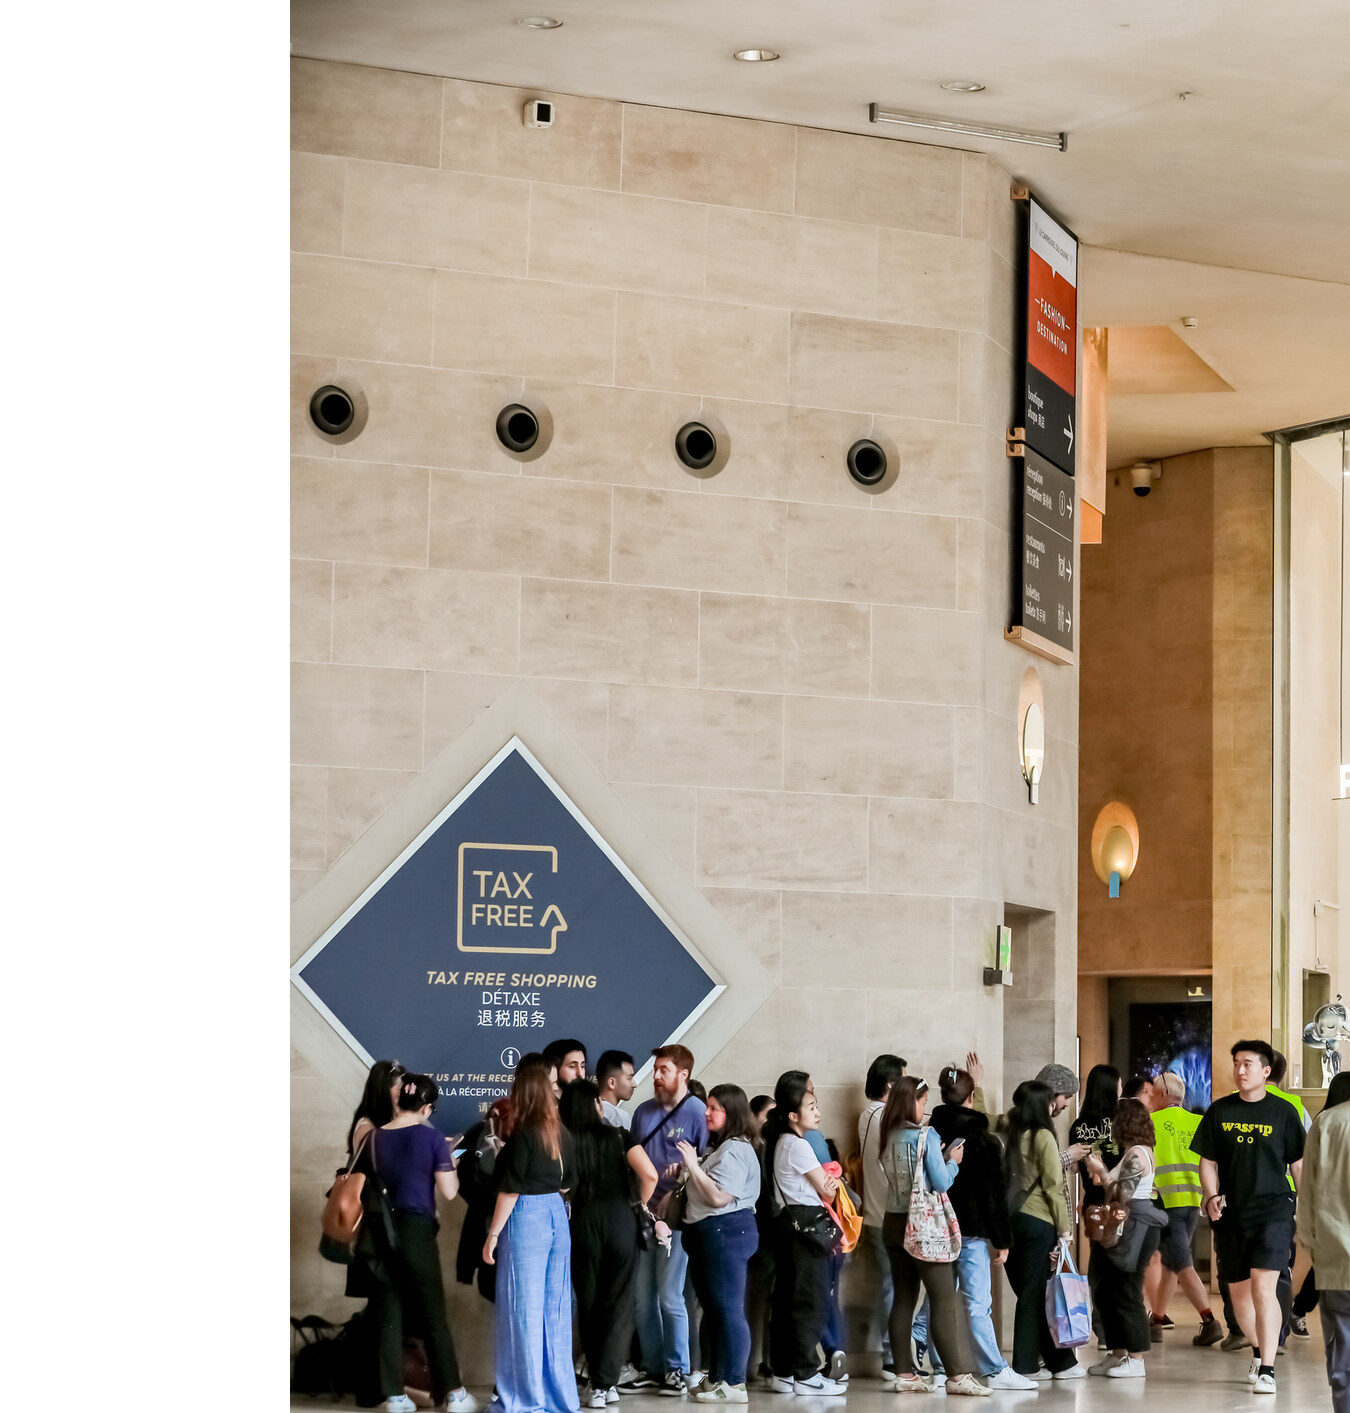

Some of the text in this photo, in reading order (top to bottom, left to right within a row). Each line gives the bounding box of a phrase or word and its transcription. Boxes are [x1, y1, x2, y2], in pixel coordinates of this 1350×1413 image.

[1041, 297, 1065, 331] FASHION
[1037, 320, 1067, 355] DESTINATION
[472, 870, 534, 899] TAX
[471, 904, 534, 927] FREE
[427, 971, 597, 988] TAX FREE SHOPPING
[482, 987, 541, 1006] DÉTAXE
[477, 1009, 546, 1028] 退税服务
[436, 1073, 450, 1082] US
[452, 1074, 465, 1082] AT
[467, 1074, 486, 1082] THE
[438, 1085, 508, 1097] À LA RÉCEPTION
